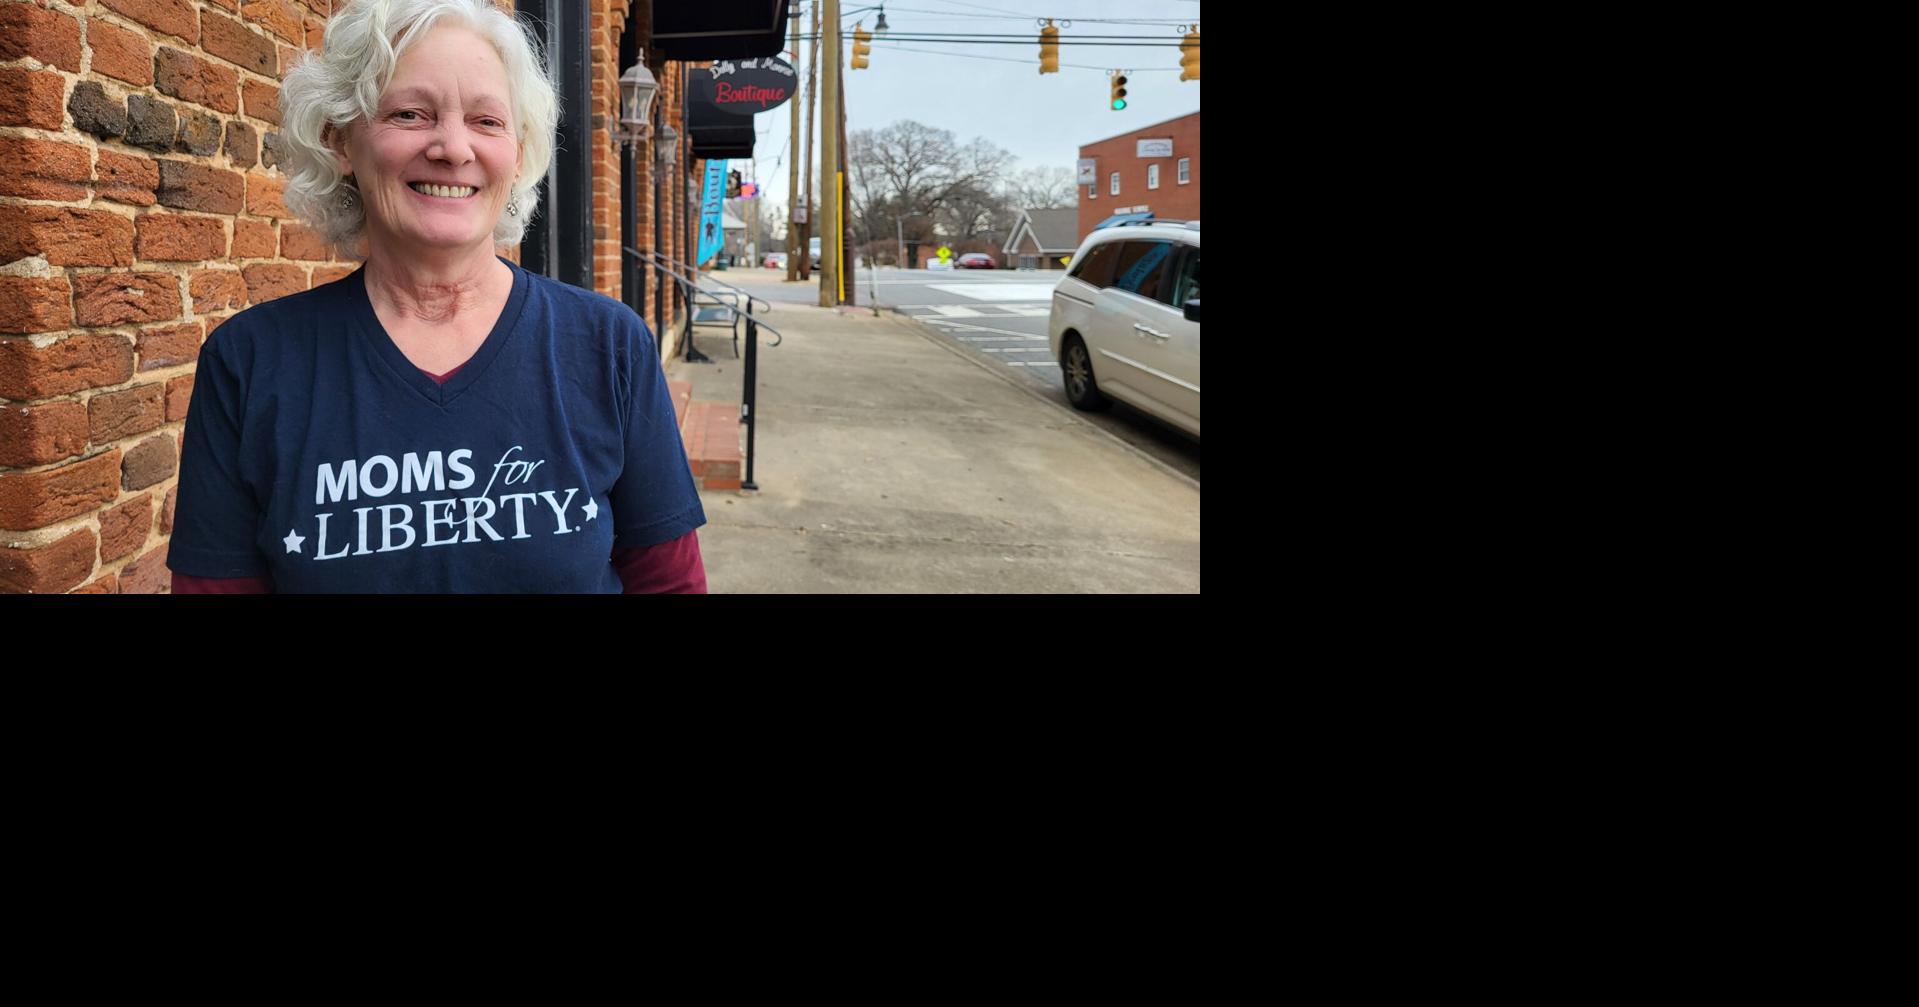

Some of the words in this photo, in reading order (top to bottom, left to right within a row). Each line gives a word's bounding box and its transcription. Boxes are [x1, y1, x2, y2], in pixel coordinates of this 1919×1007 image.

[741, 58, 759, 69] and
[715, 81, 785, 108] Boutique
[315, 449, 475, 504] MOMS
[444, 446, 545, 525] for
